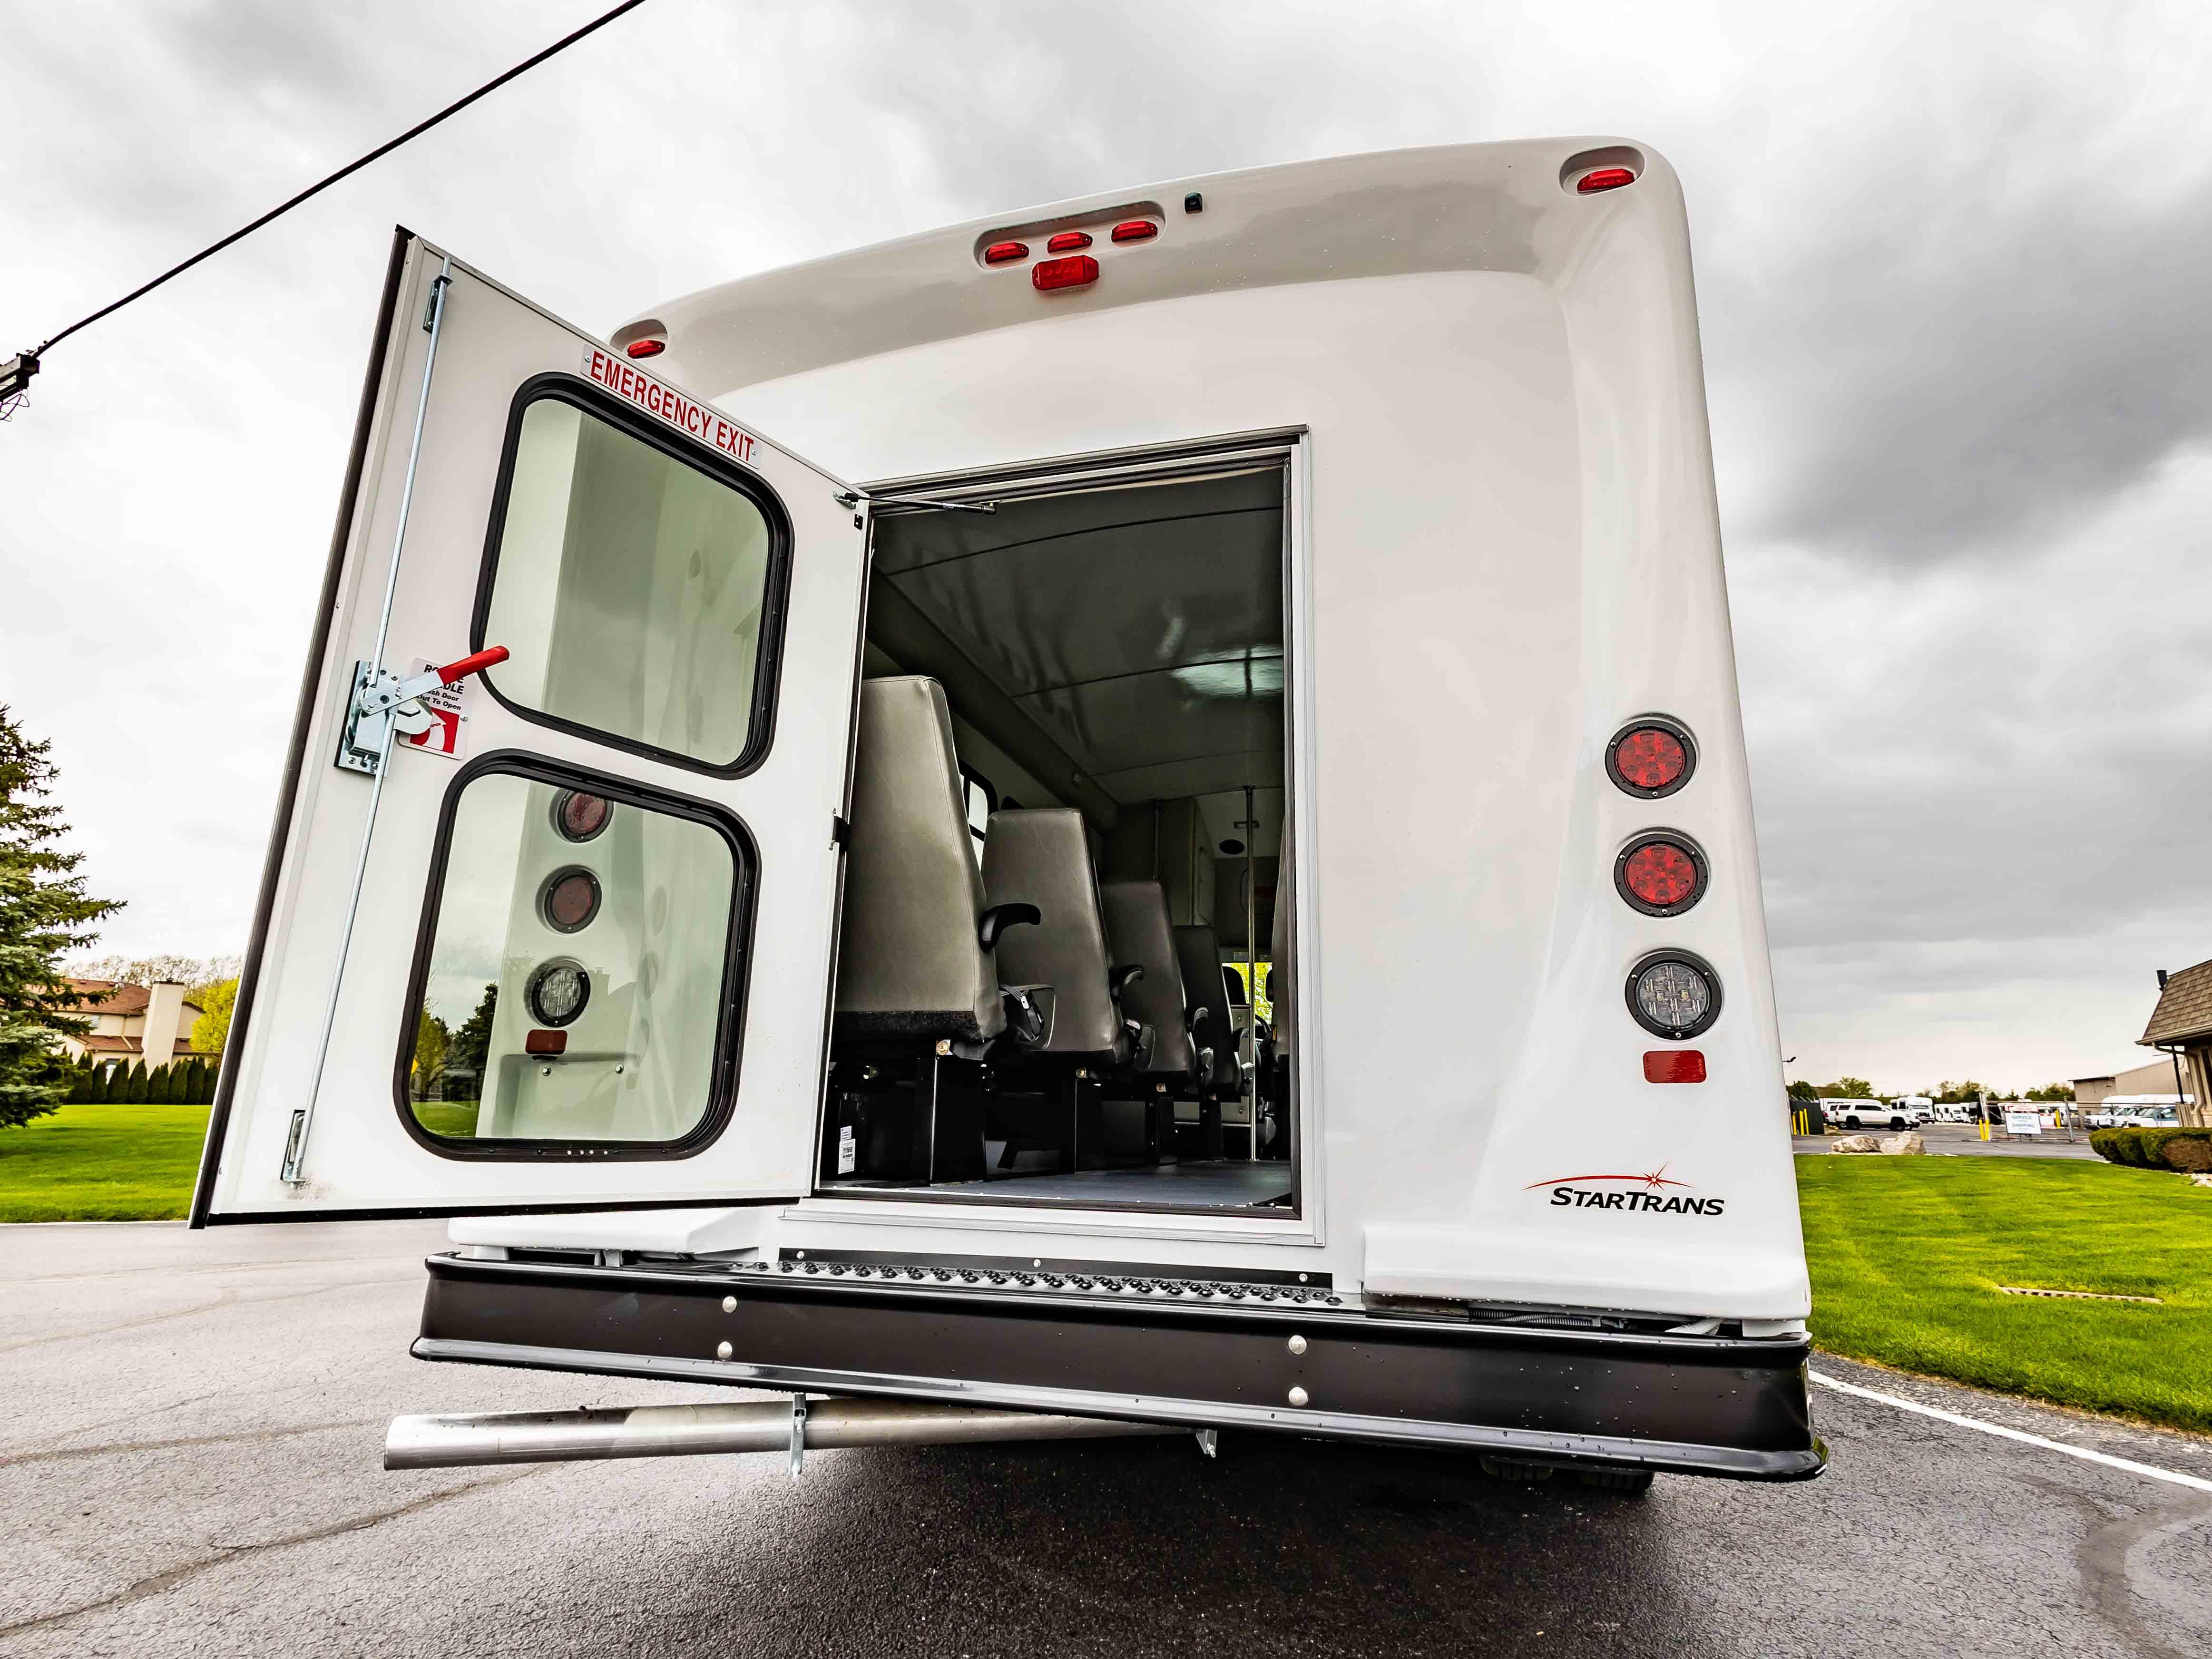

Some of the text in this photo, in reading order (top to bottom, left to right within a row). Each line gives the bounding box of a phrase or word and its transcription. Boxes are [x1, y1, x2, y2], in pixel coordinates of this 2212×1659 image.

[590, 351, 754, 461] EMERGENCY EXIT
[441, 692, 459, 702] Door
[443, 701, 461, 711] Open
